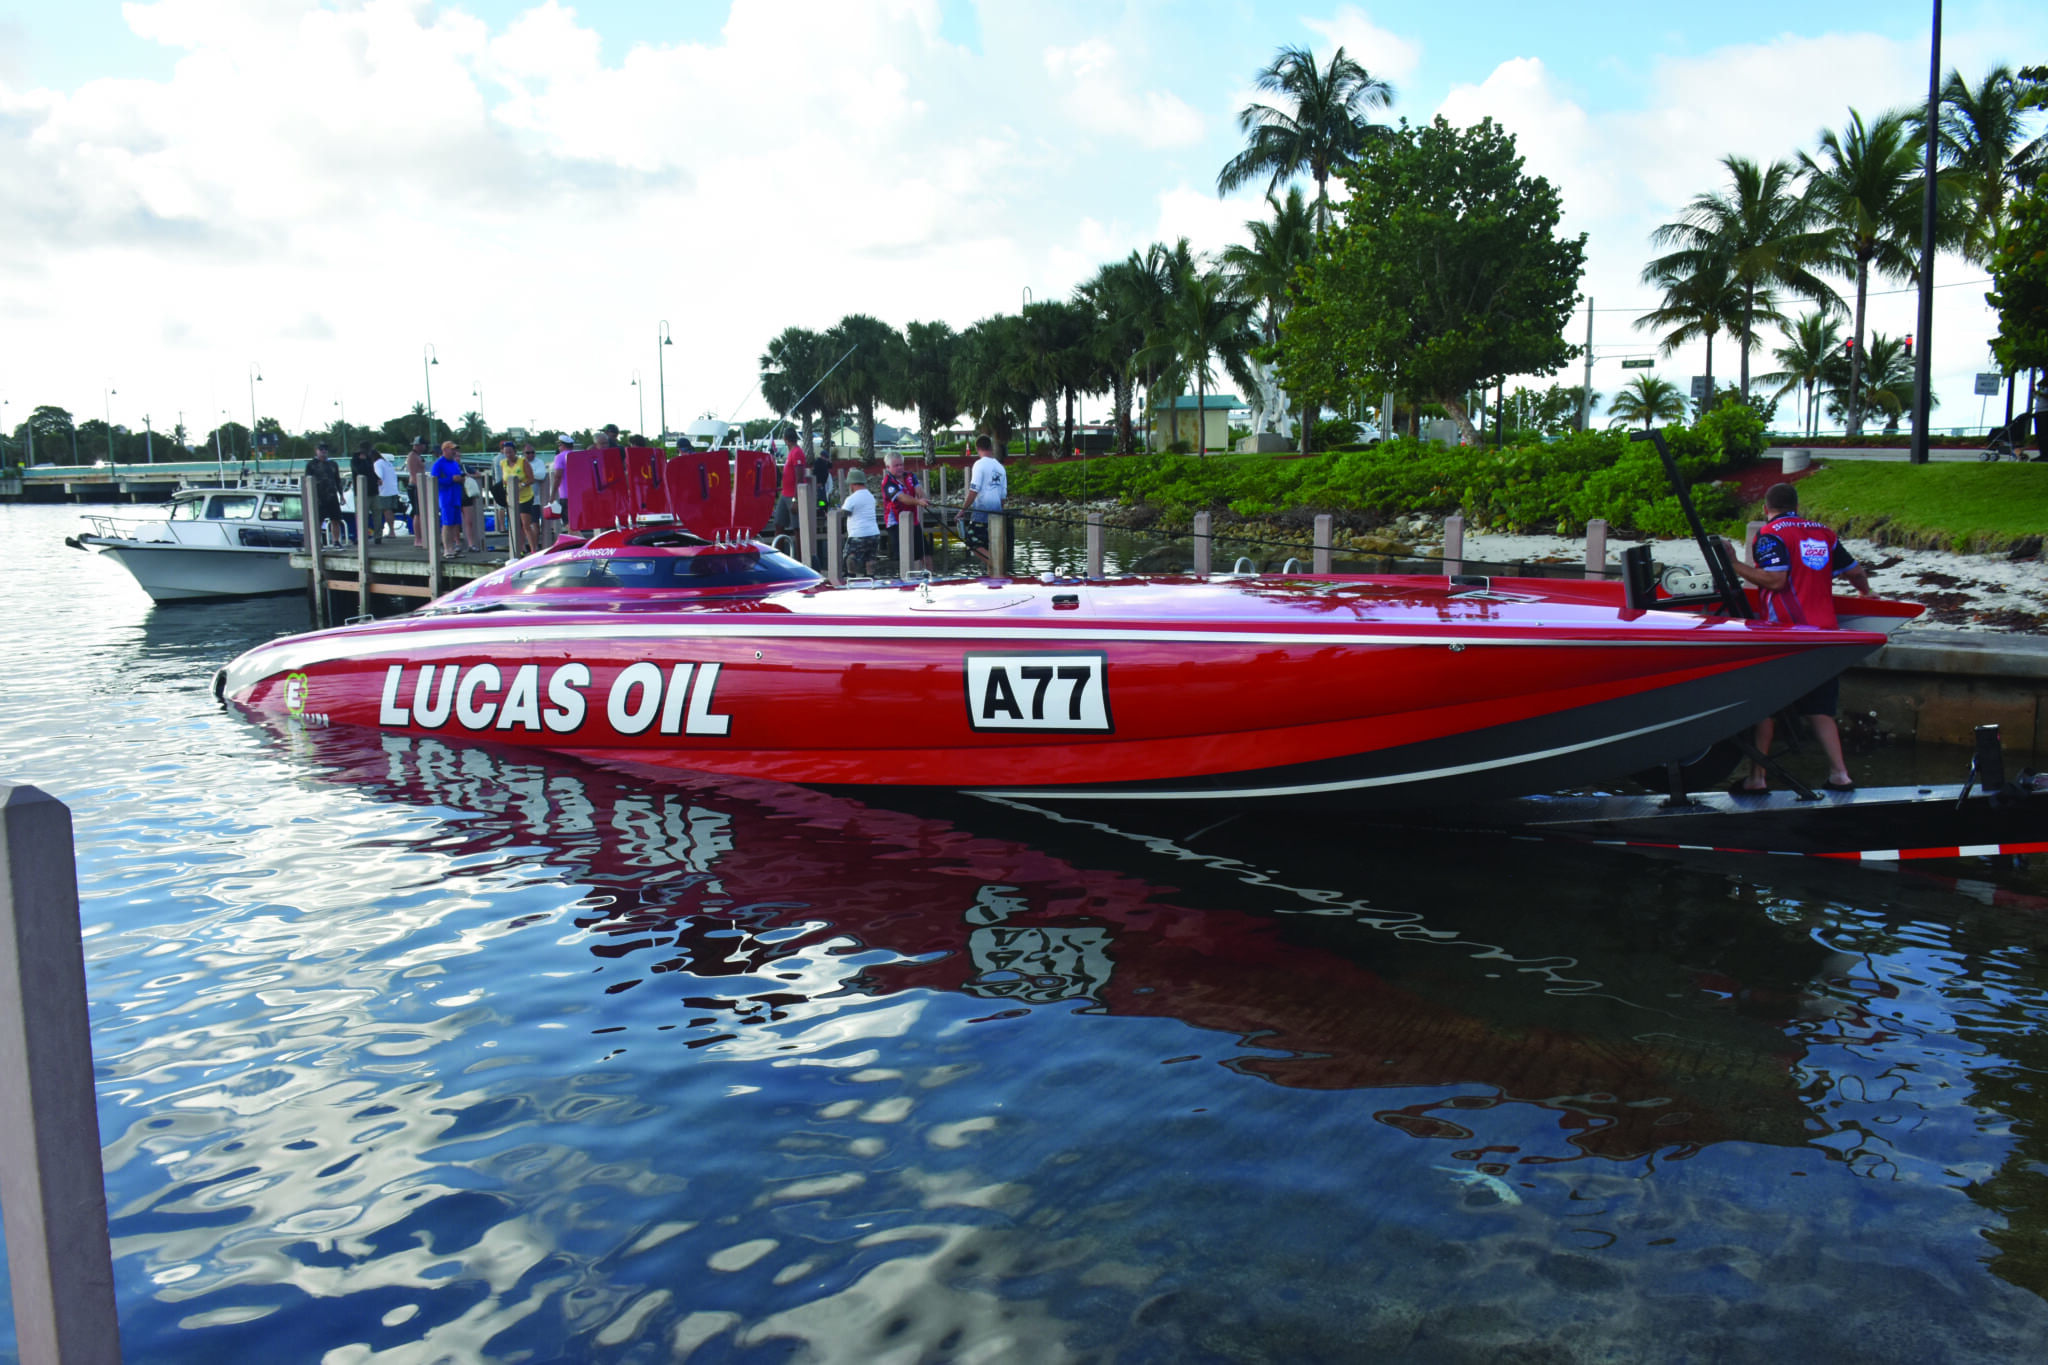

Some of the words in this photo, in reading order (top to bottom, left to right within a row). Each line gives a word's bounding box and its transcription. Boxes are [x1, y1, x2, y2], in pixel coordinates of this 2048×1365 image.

[379, 662, 591, 732] LUCAS
[606, 661, 733, 736] OIL
[982, 666, 1091, 720] A77
